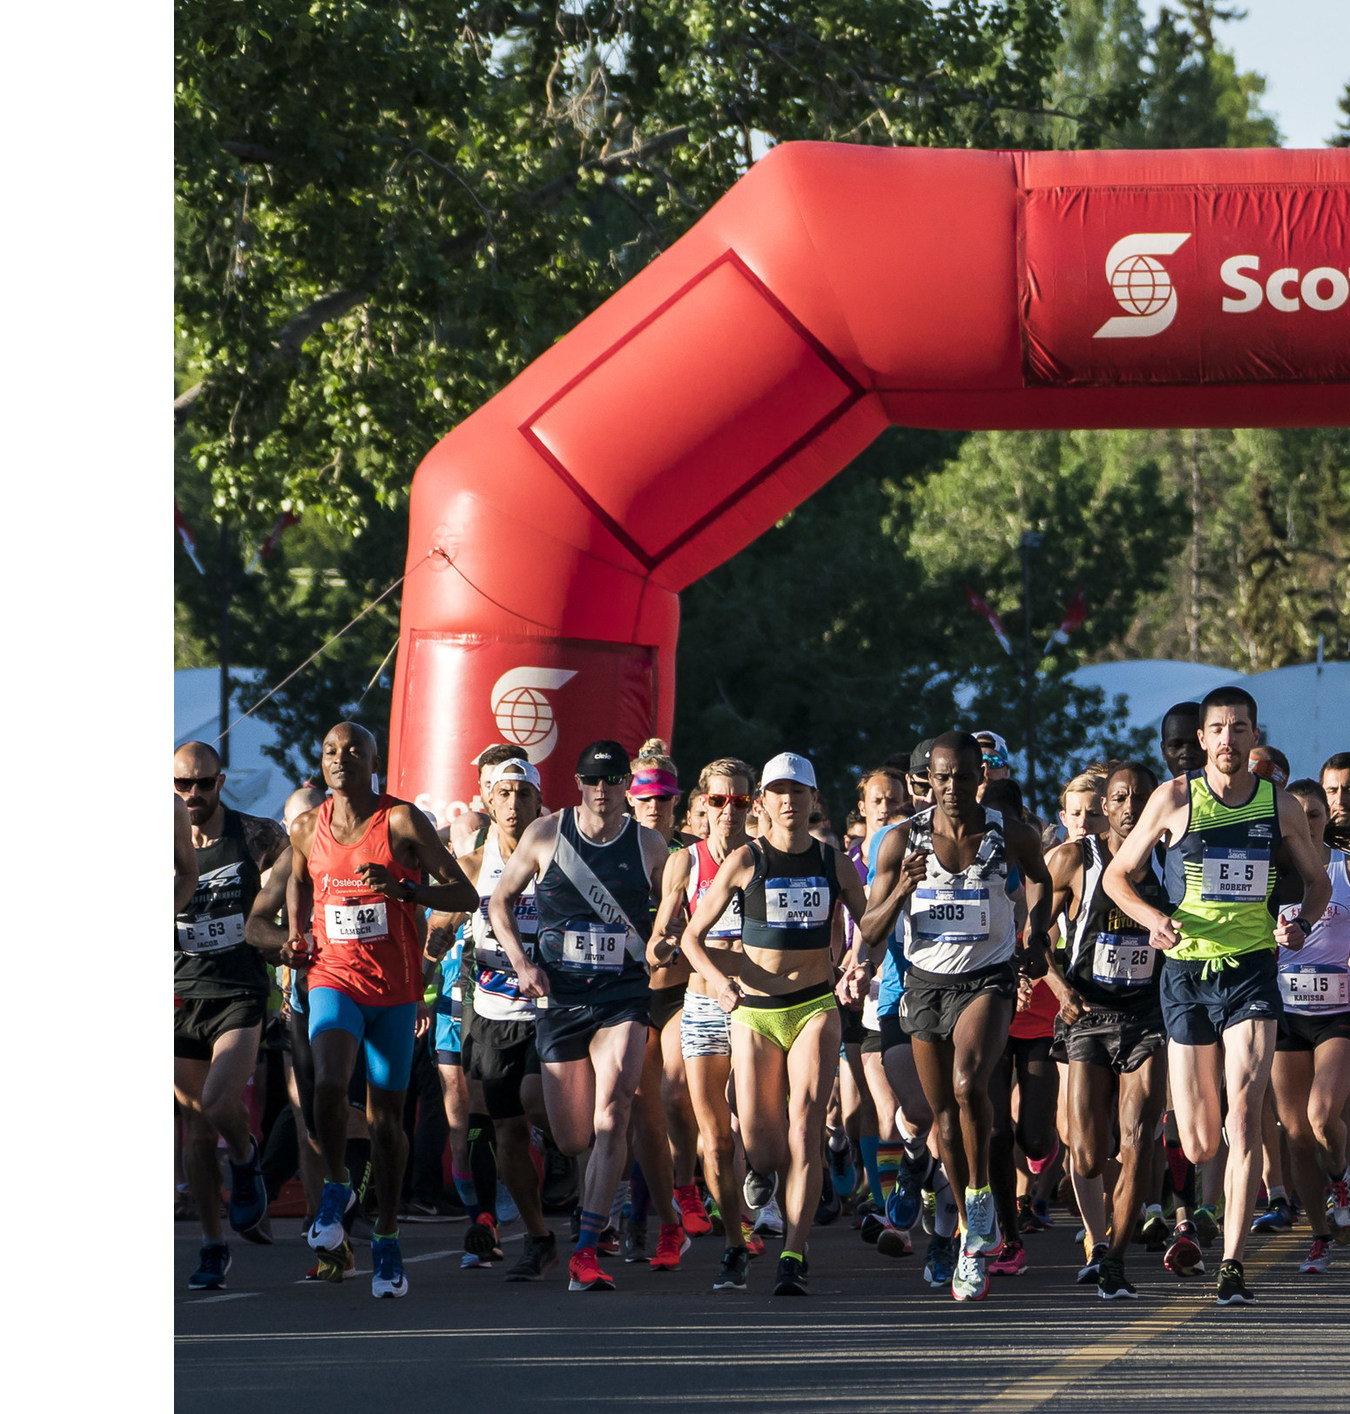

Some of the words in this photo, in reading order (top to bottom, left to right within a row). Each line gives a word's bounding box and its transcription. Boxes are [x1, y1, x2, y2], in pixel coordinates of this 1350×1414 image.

[1220, 864, 1229, 880] E
[1245, 865, 1254, 881] 5
[1220, 884, 1252, 892] ROBERT
[779, 893, 788, 908] E
[803, 891, 820, 907] 20
[336, 911, 342, 925] E
[357, 909, 376, 924] 42
[929, 905, 964, 920] 5303
[186, 928, 195, 940] E
[208, 922, 225, 937] 63
[340, 926, 371, 935] LAMECH
[576, 936, 585, 950] E
[600, 937, 615, 952] 18
[1107, 950, 1116, 964] E
[1131, 950, 1148, 965] 26
[1290, 978, 1298, 992] E
[1313, 978, 1328, 992] 15
